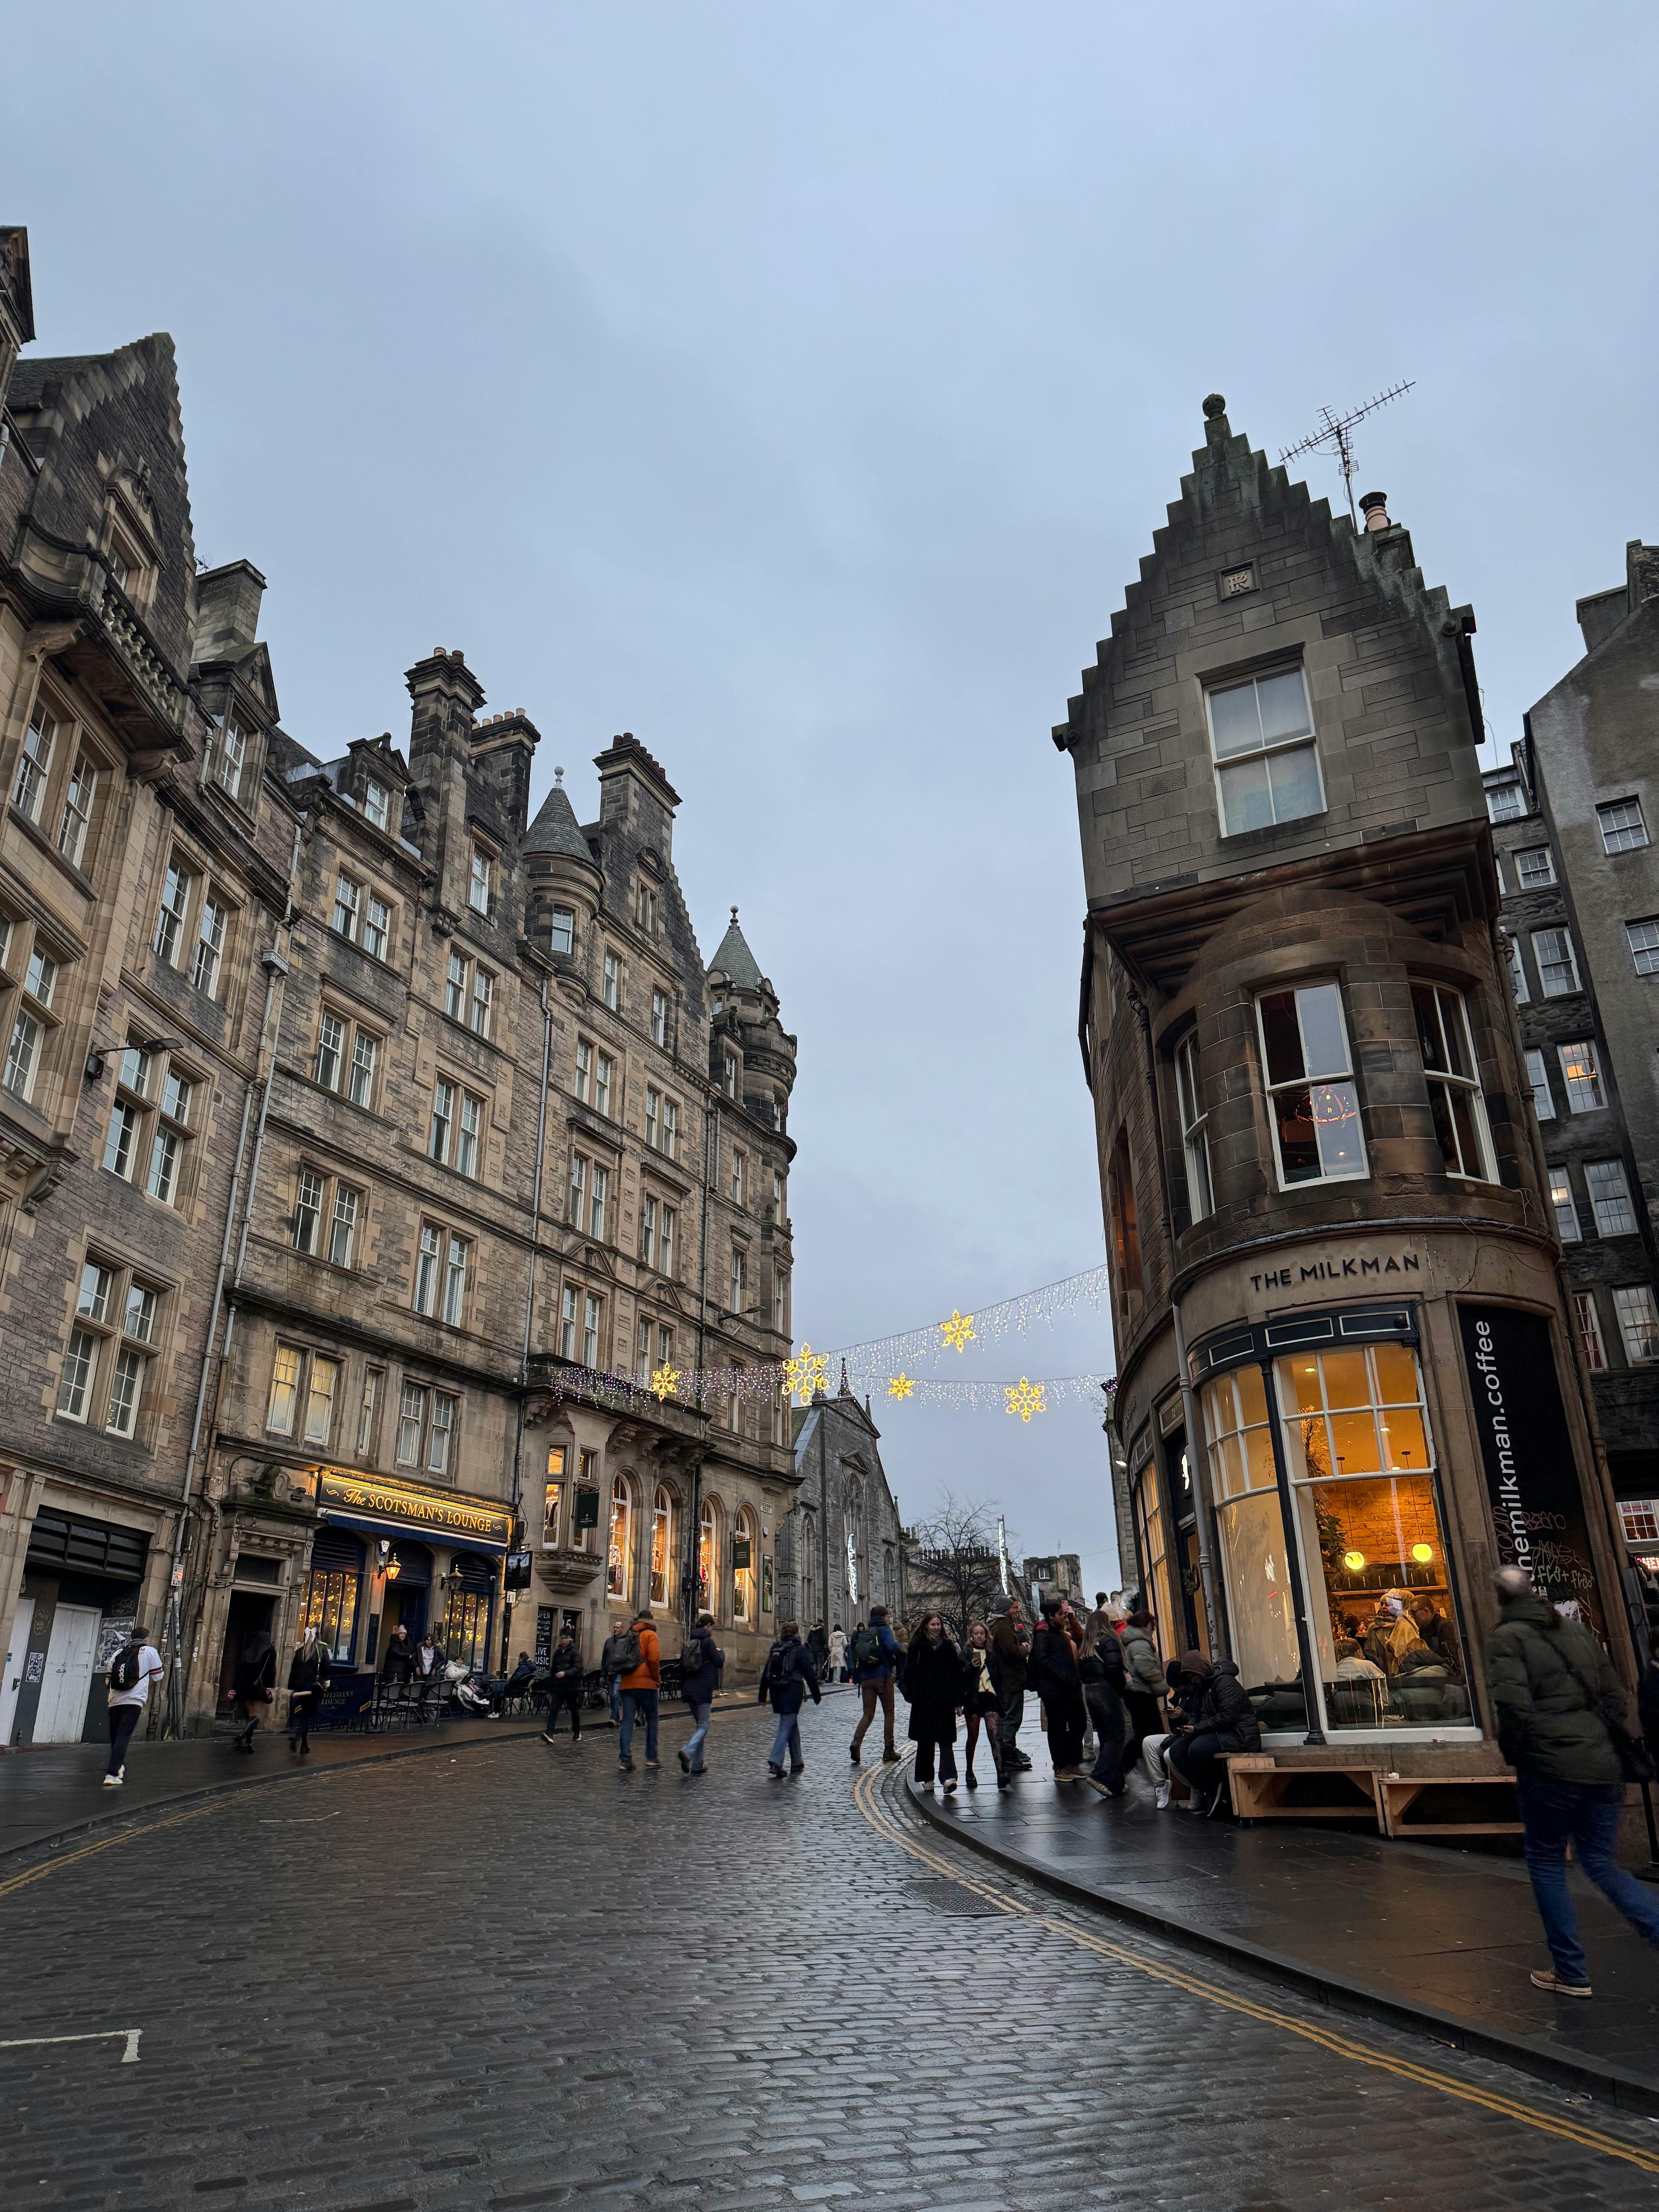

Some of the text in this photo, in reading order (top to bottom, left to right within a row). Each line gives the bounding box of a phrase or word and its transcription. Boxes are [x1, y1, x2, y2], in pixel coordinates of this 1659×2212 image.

[1250, 1254, 1419, 1291] THE MILKMAN
[343, 1488, 491, 1532] The SCOTSMAN'S LOUNGE
[535, 1657, 549, 1665] USIC
